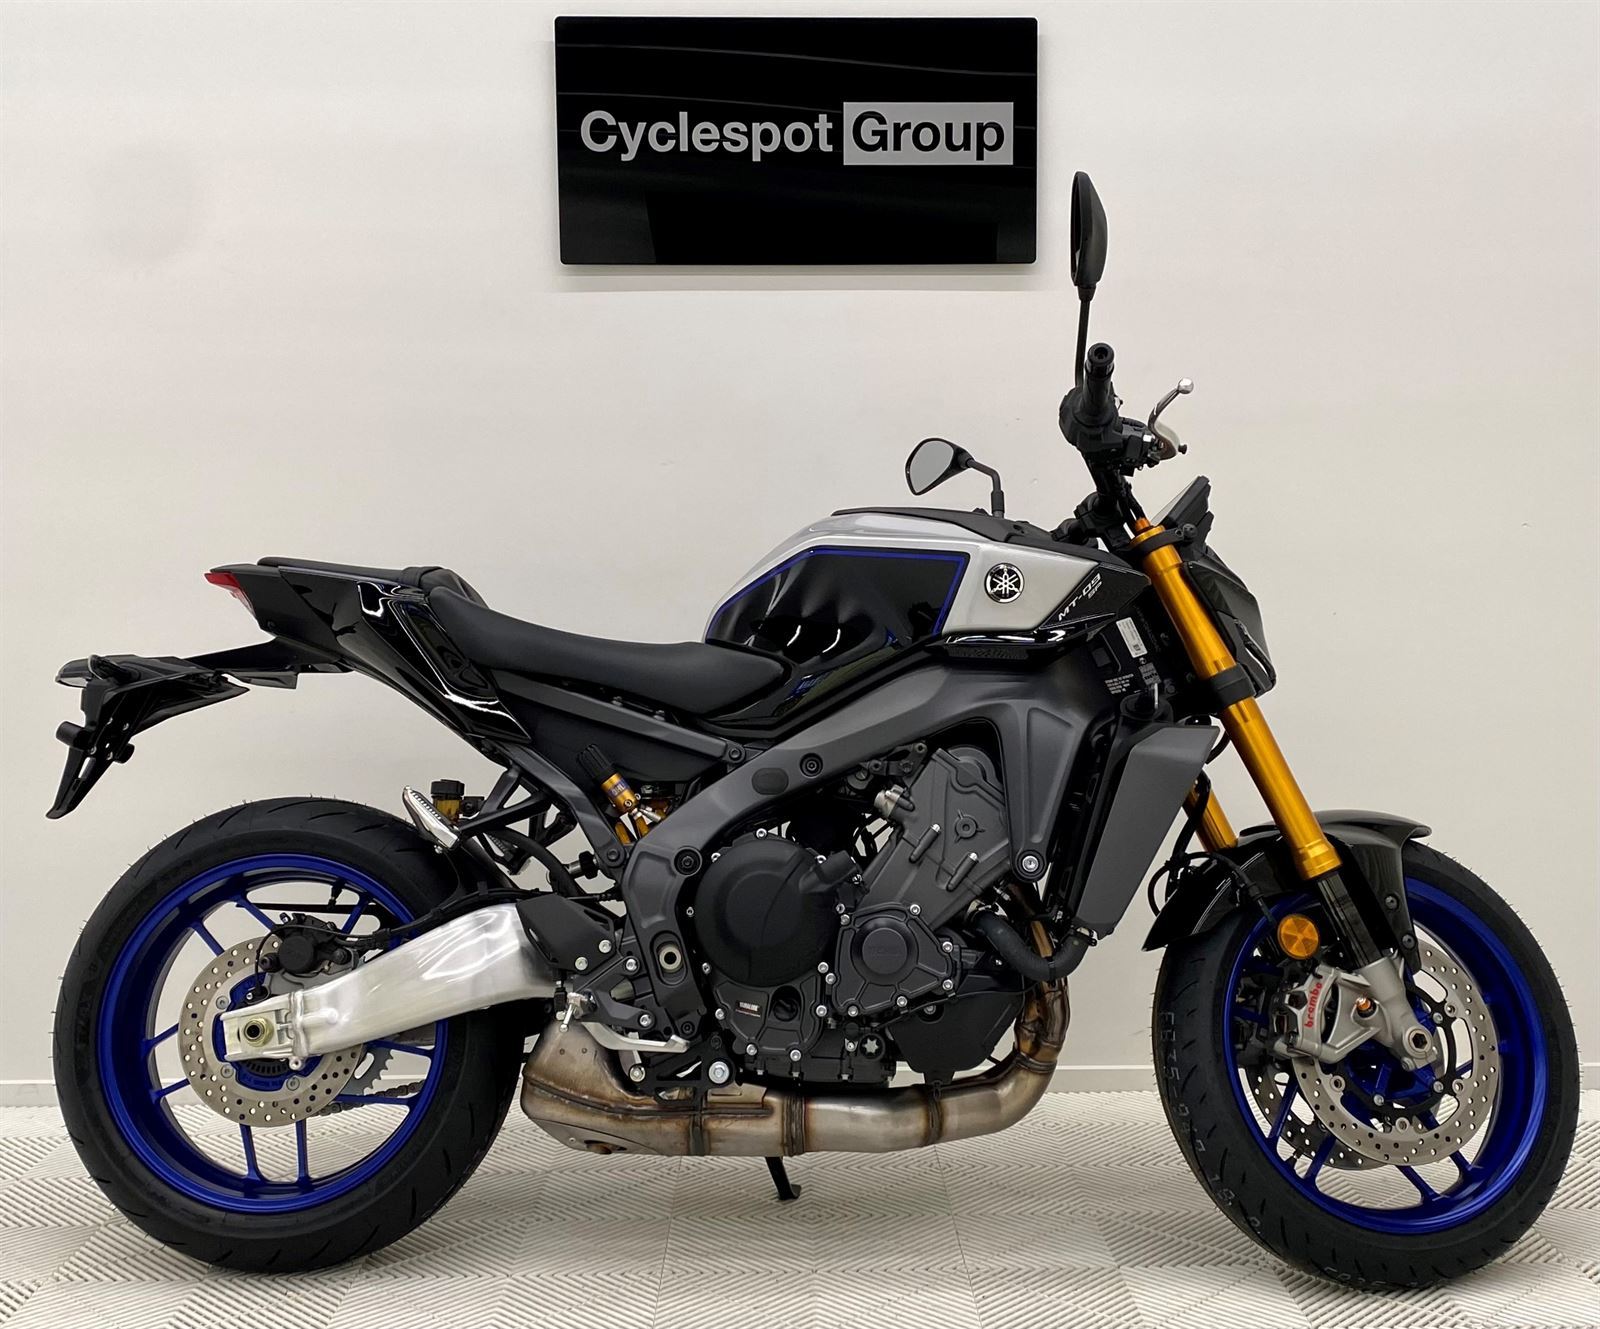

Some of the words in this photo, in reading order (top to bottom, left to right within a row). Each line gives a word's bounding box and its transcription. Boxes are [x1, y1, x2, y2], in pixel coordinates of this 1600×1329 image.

[580, 109, 834, 162] Cyclespot
[851, 110, 1006, 162] Group
[1058, 572, 1101, 621] MT-09
[1304, 982, 1323, 1028] brembo
